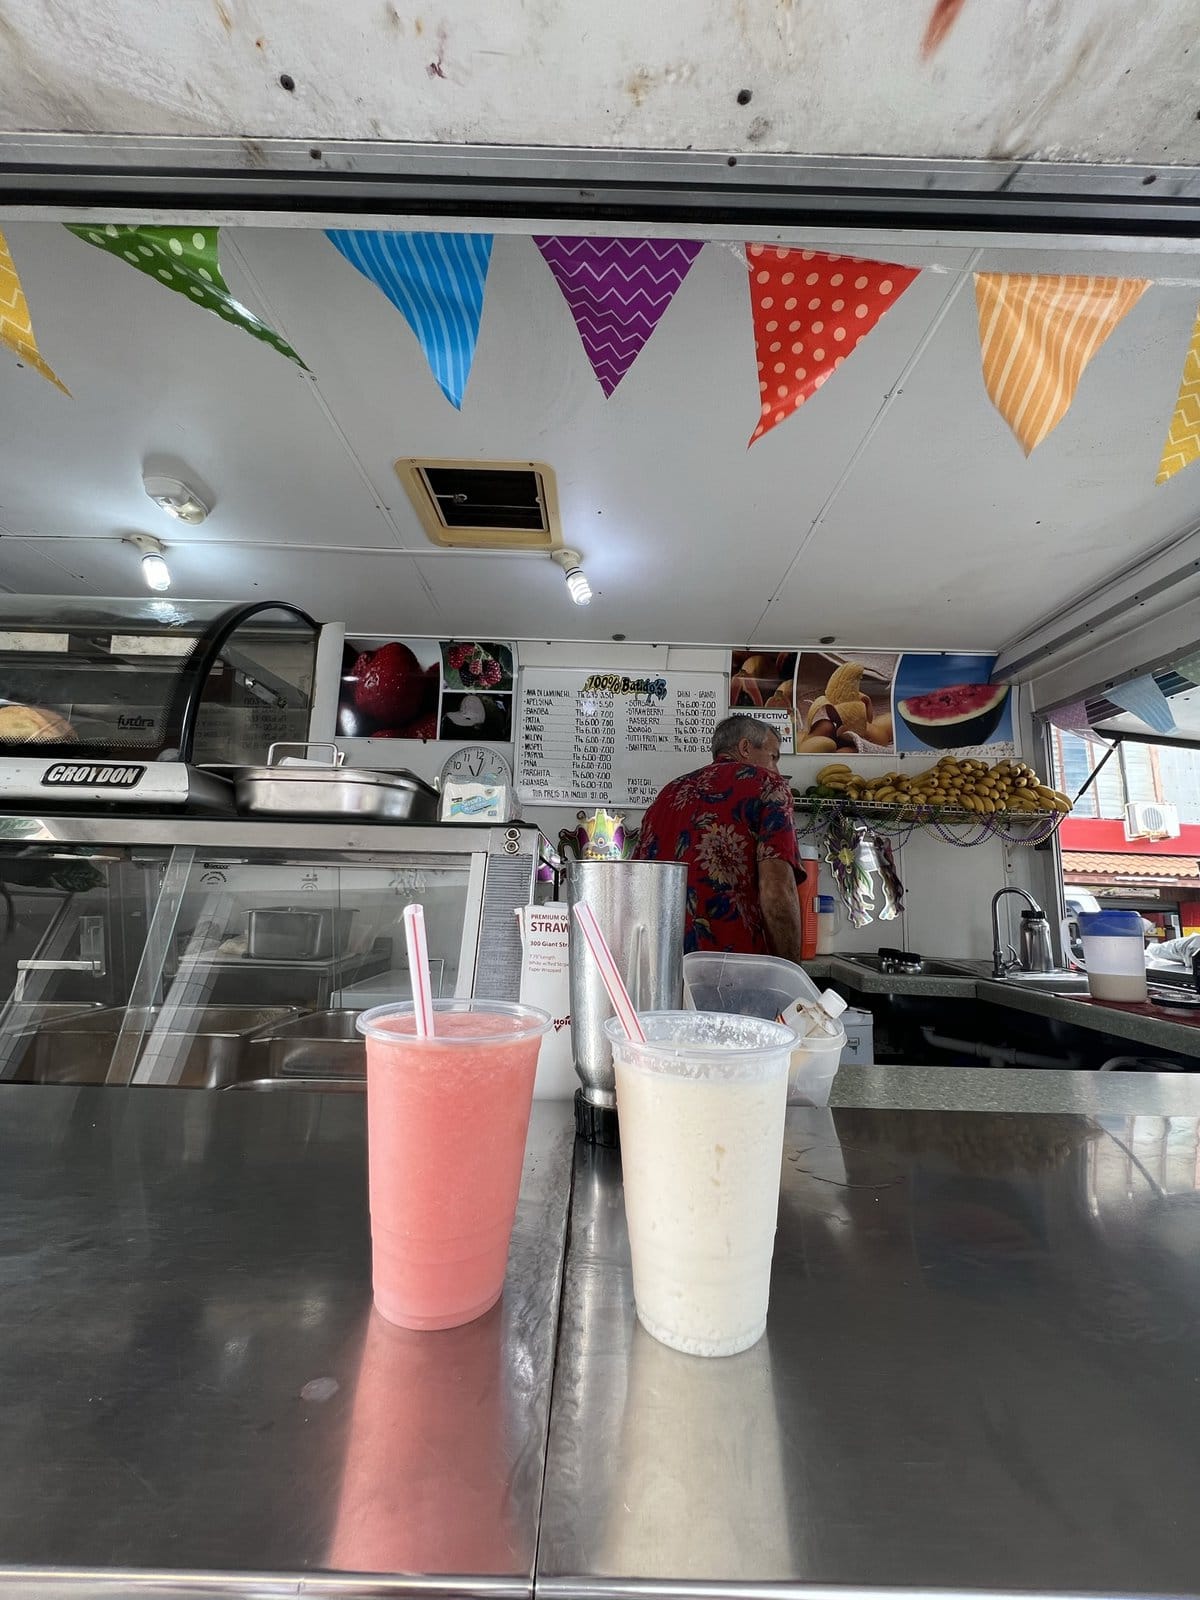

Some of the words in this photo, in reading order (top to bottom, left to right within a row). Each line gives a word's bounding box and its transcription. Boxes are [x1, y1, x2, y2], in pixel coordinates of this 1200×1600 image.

[587, 675, 620, 693] 100%
[464, 754, 470, 762] 11
[476, 751, 484, 759] 12
[454, 762, 461, 770] 10
[47, 766, 140, 783] CROYDON
